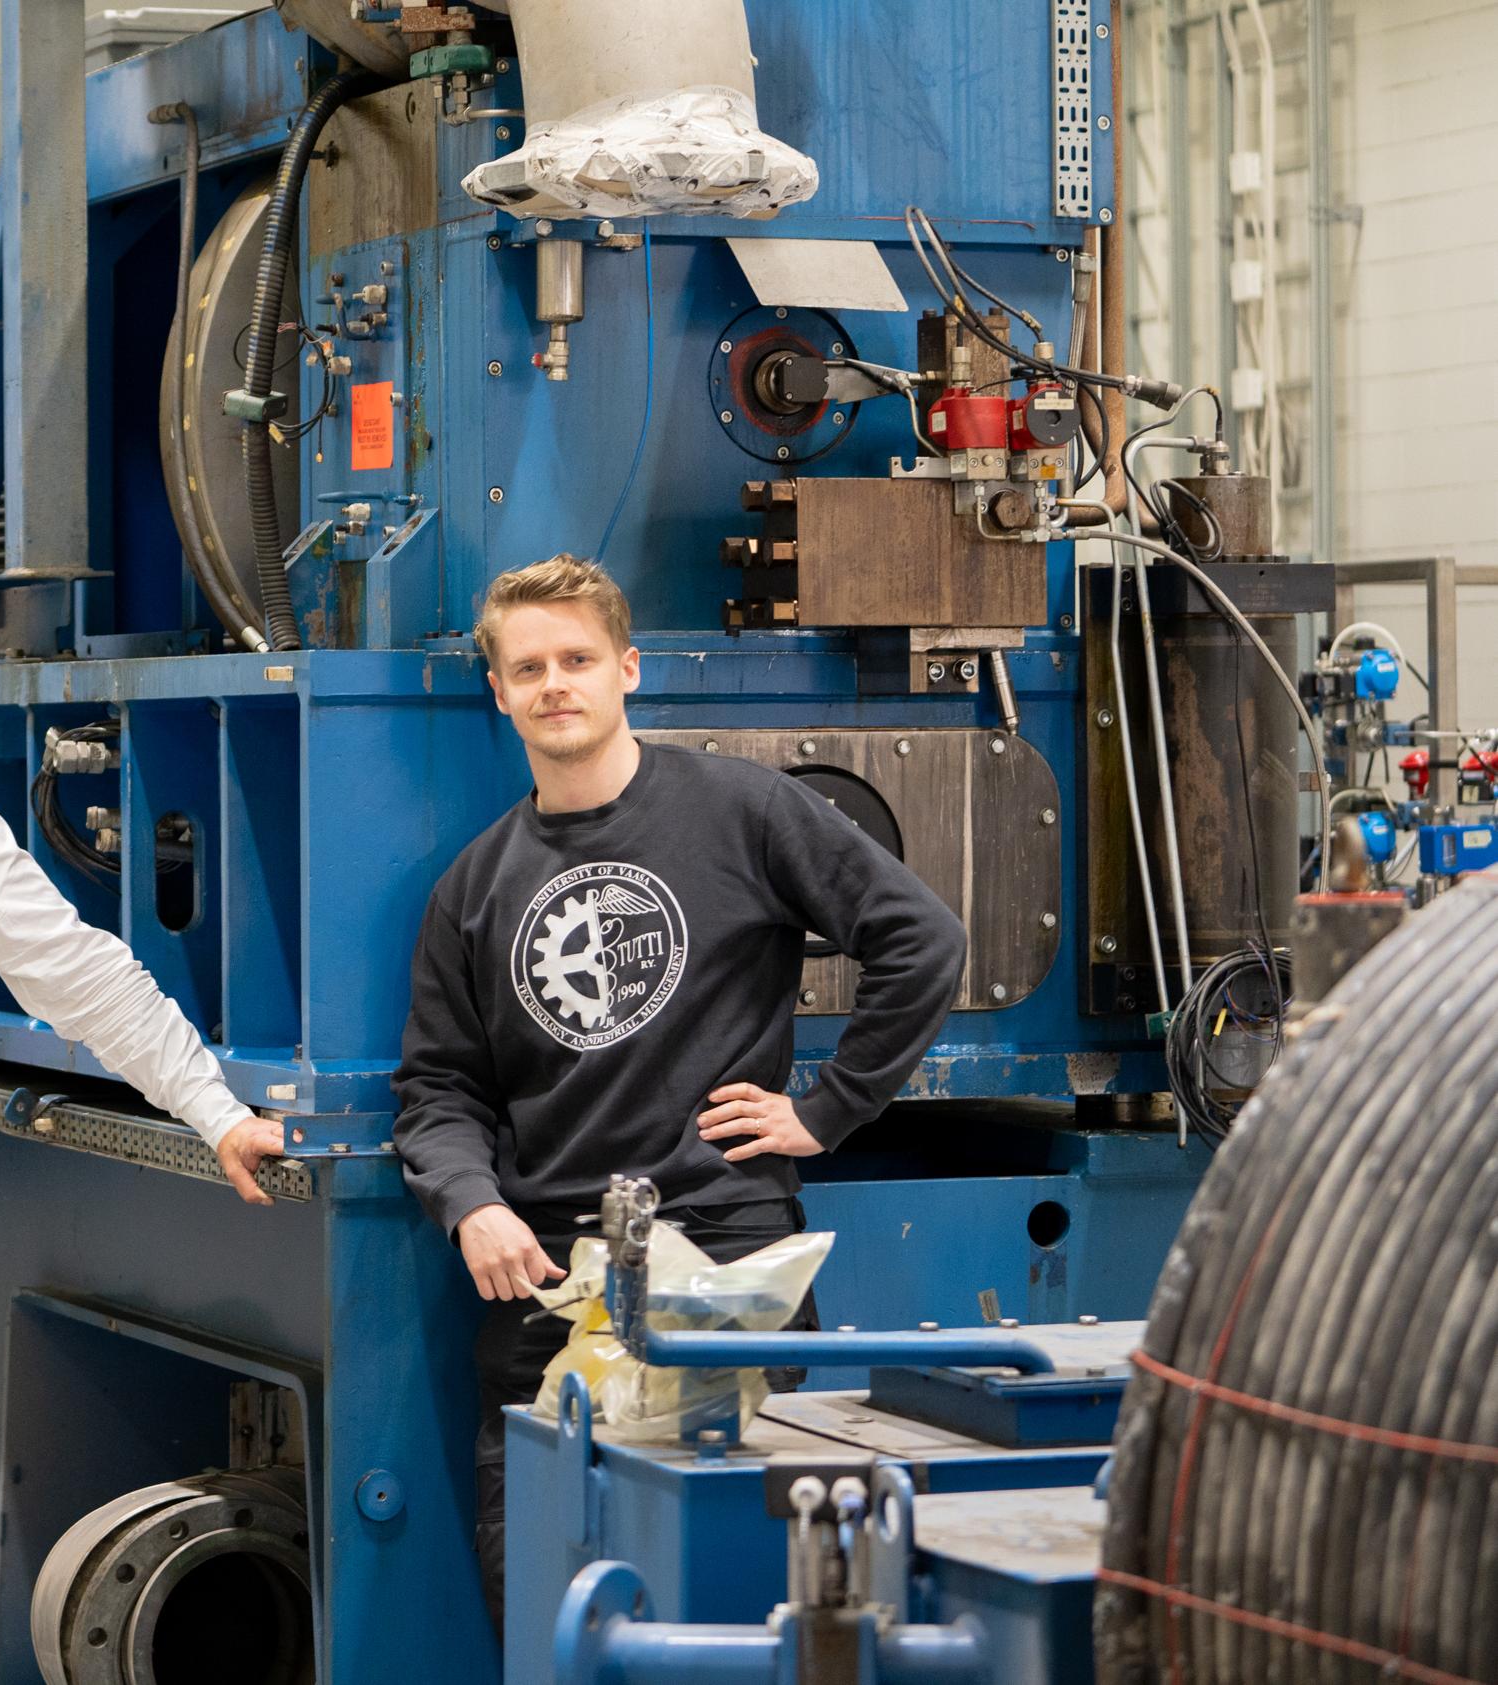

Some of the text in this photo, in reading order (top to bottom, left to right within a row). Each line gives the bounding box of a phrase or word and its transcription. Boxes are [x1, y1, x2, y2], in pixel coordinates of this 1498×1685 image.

[532, 866, 650, 910] UNIVERSITY OF VAASA
[617, 931, 664, 967] TUTTI
[518, 981, 569, 1040] TECHNOLOGY
[640, 944, 684, 1020] MANAGEMENT
[617, 980, 646, 1003] 1990
[901, 1222, 913, 1239] 7
